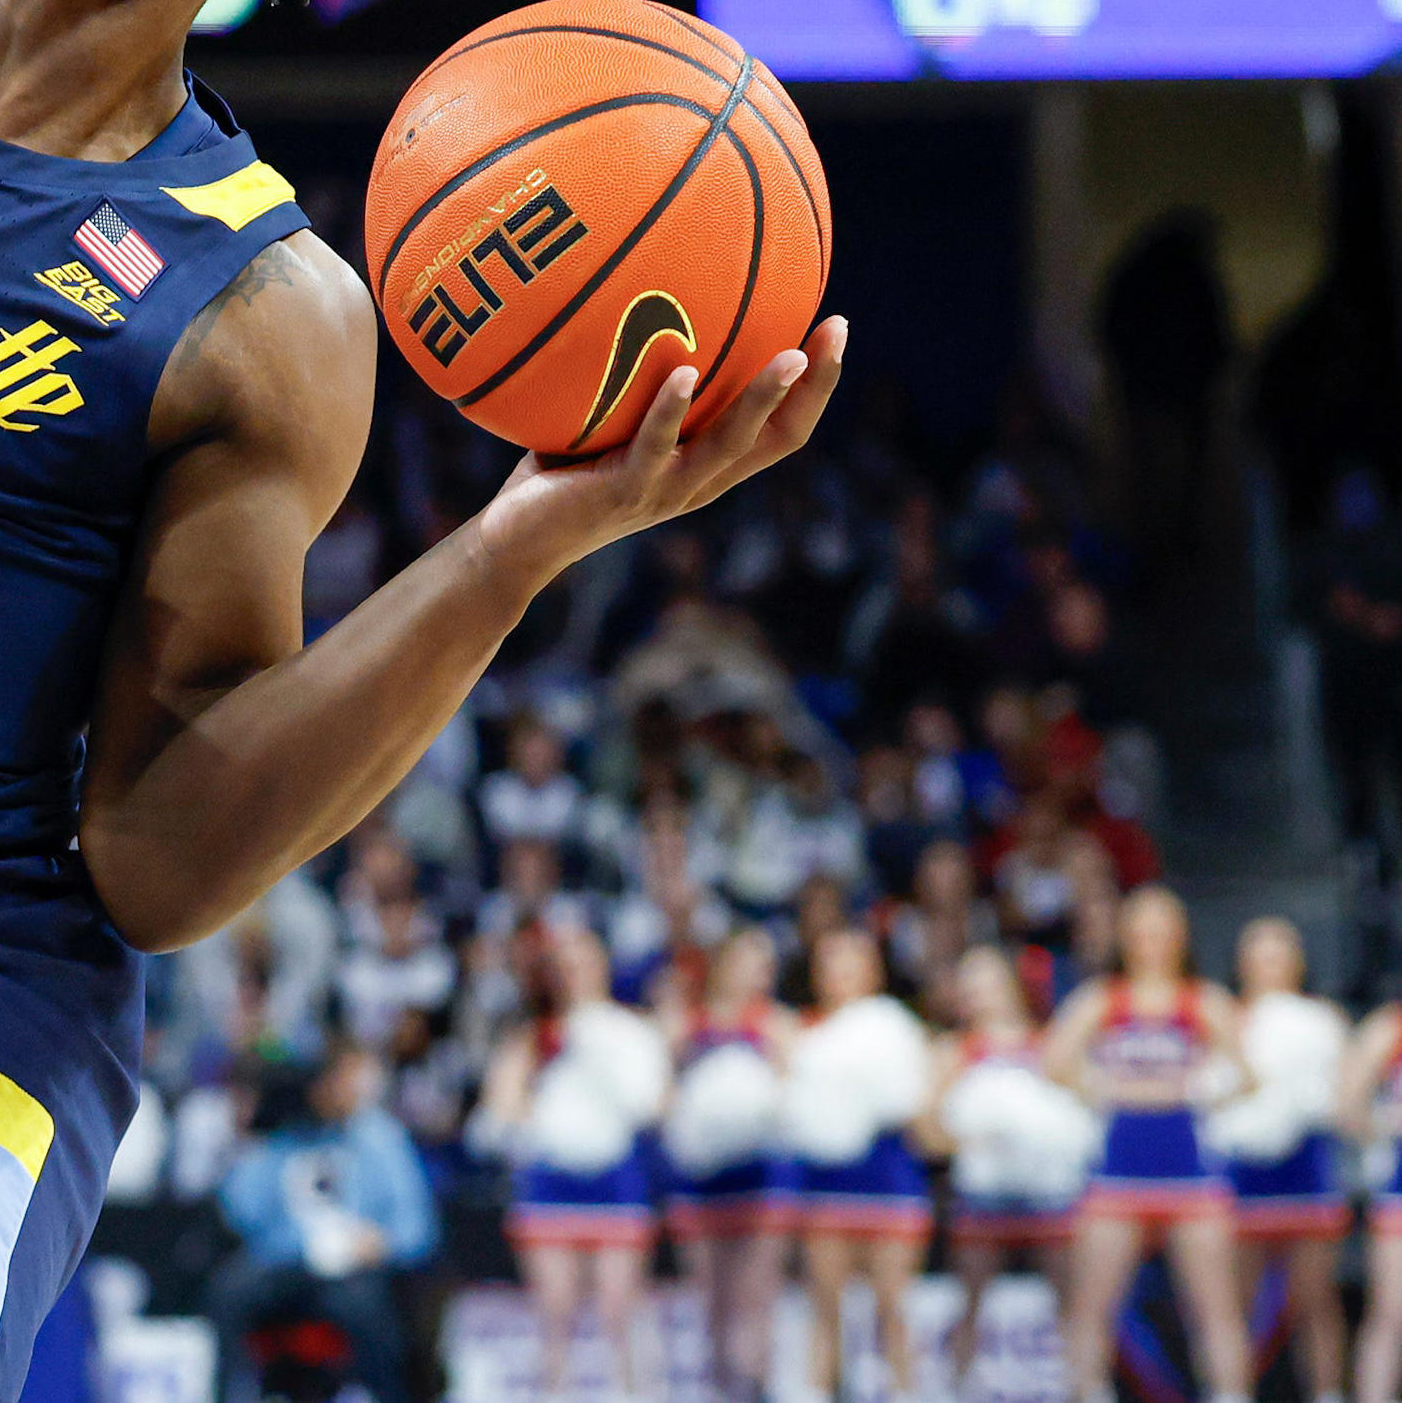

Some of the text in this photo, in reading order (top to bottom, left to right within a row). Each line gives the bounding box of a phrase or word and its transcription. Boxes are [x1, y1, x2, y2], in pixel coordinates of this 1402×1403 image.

[43, 266, 127, 322] EAST
[60, 260, 122, 304] BIG
[407, 182, 591, 369] ELITE
